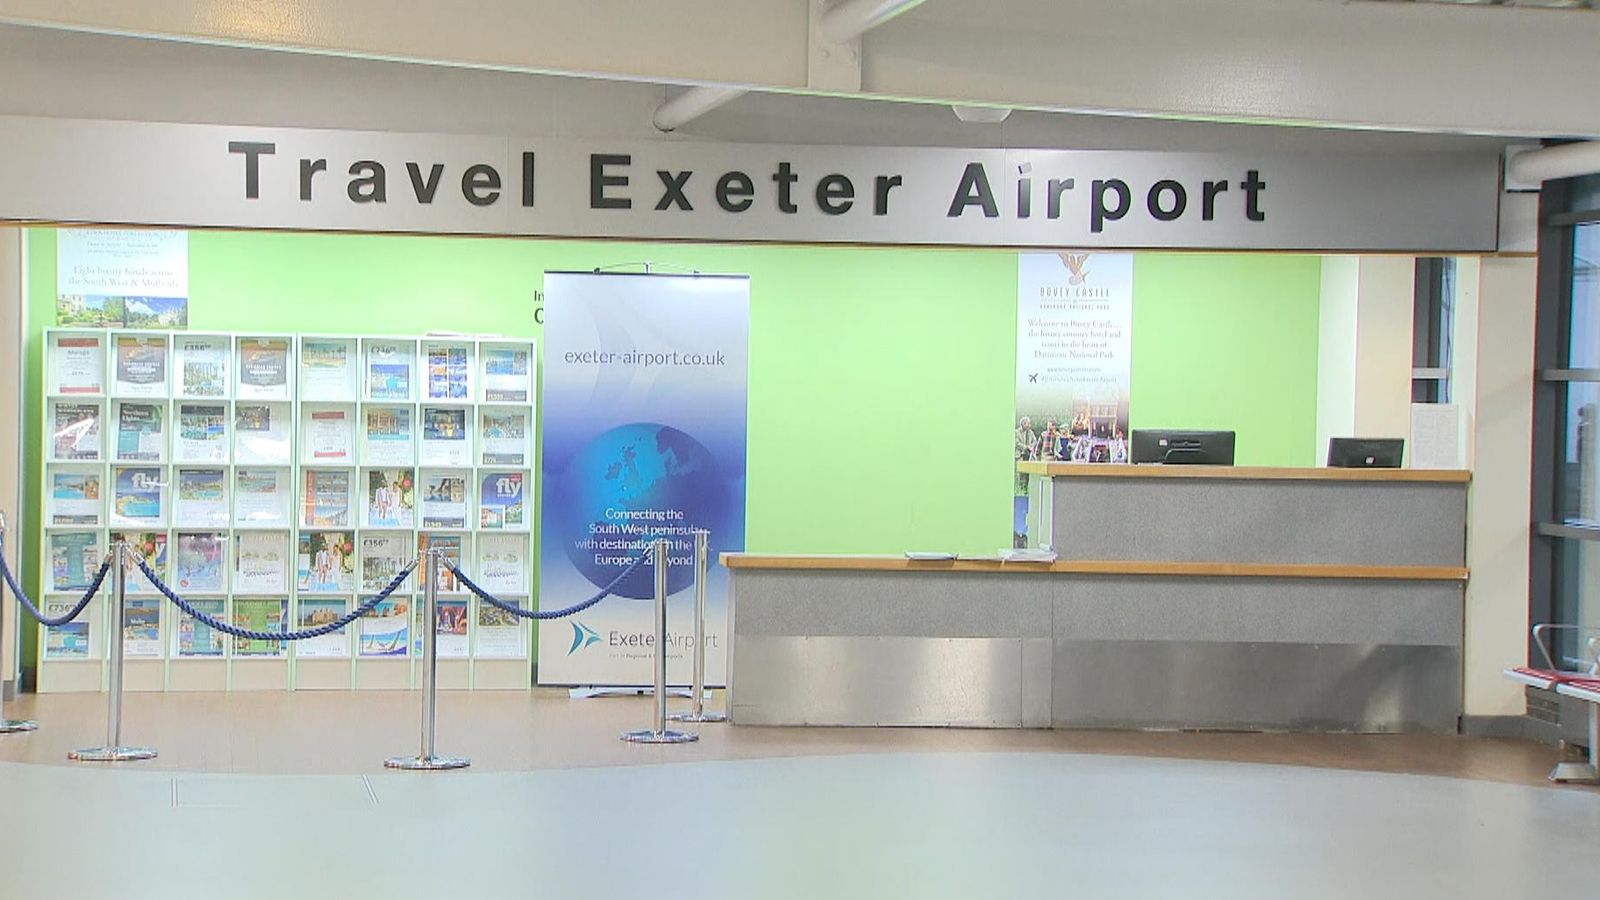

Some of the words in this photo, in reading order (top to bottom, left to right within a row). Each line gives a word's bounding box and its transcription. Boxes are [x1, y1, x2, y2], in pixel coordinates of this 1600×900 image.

[228, 141, 536, 208] Travel
[590, 153, 902, 216] Exeter
[947, 162, 1266, 233] Airport
[1040, 286, 1070, 297] BOVEY
[1027, 319, 1059, 328] Welcome
[1108, 330, 1121, 339] and
[564, 349, 725, 368] exeter-airport.co.uk
[1069, 350, 1098, 360] National
[495, 477, 522, 499] fly
[605, 507, 665, 522] Connecting
[666, 509, 684, 520] the
[588, 523, 620, 535] South
[621, 523, 649, 536] West
[575, 538, 598, 550] with
[674, 539, 692, 550] the
[594, 553, 632, 568] Europe
[609, 630, 656, 648] Exete
[665, 631, 718, 650] Airprt
